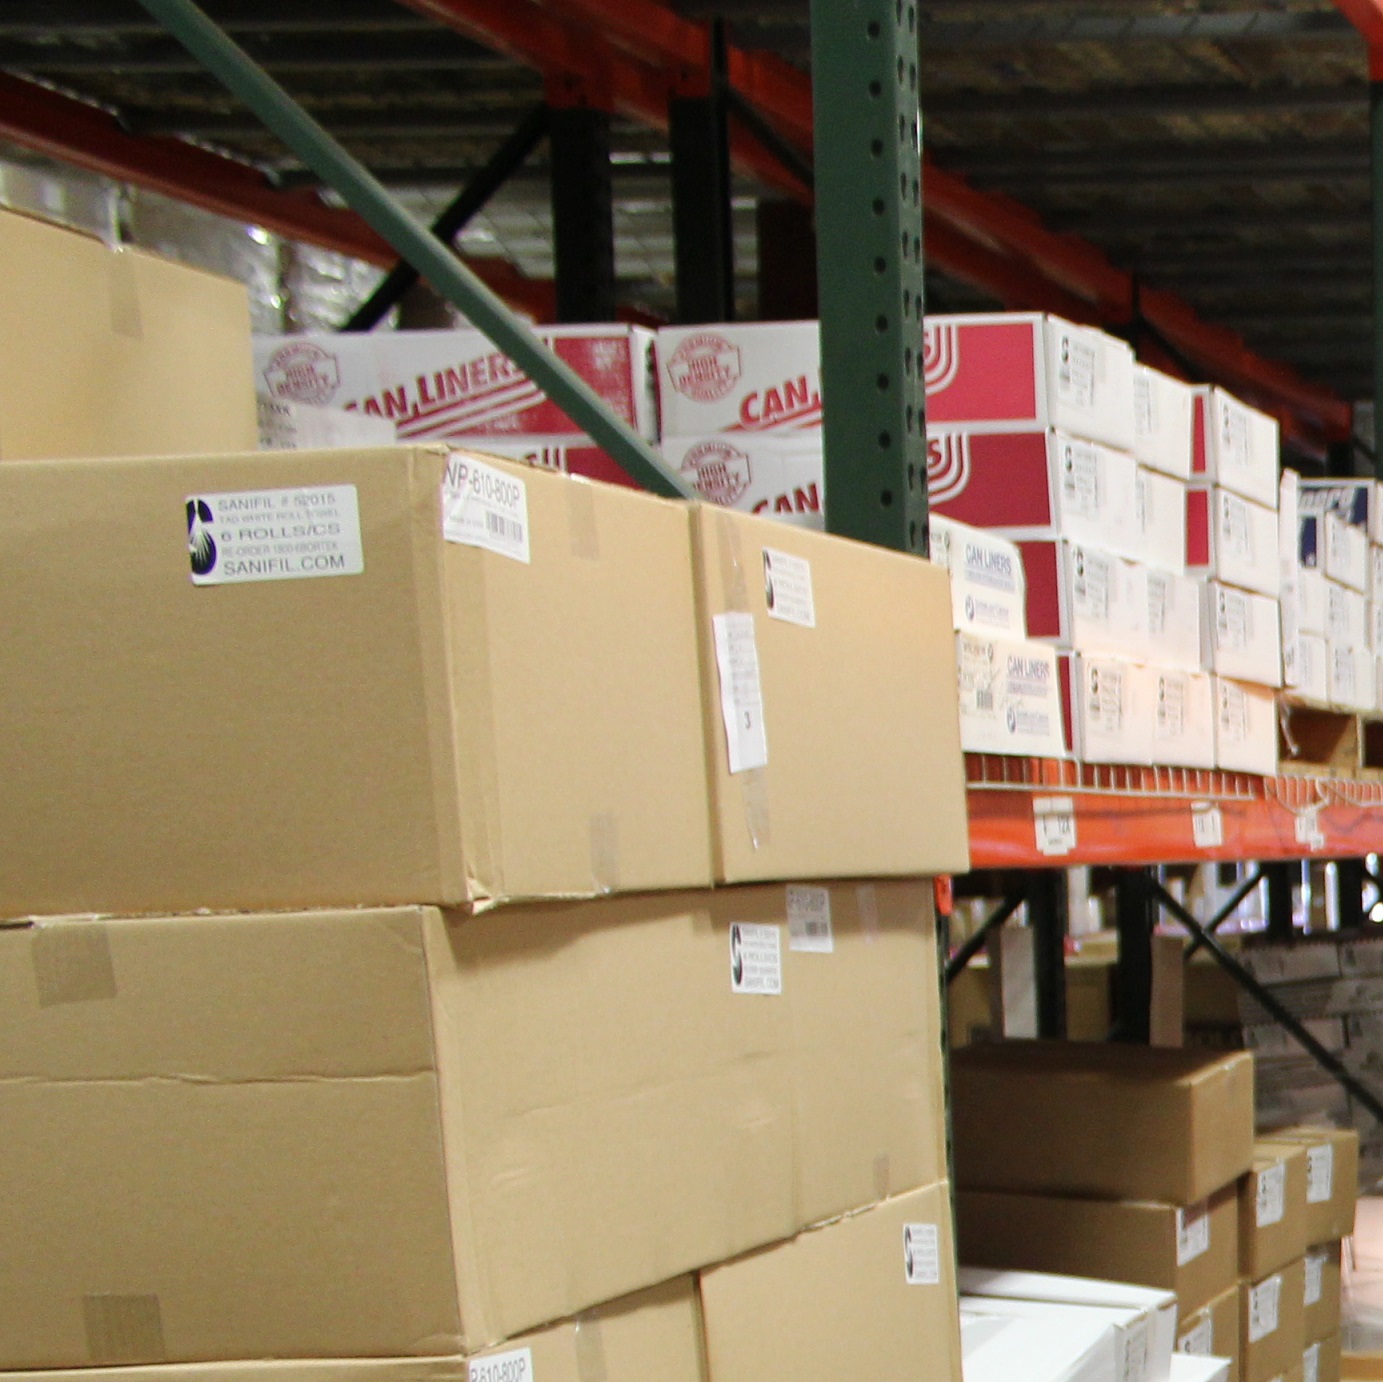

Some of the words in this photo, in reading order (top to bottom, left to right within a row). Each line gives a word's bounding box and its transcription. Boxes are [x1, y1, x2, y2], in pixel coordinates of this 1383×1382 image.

[218, 497, 274, 511] SANIFIL
[221, 531, 232, 542] 6
[239, 523, 340, 540] ROLLS/CS
[223, 555, 345, 576] SANIFIL.COM
[984, 549, 1012, 575] LINERS
